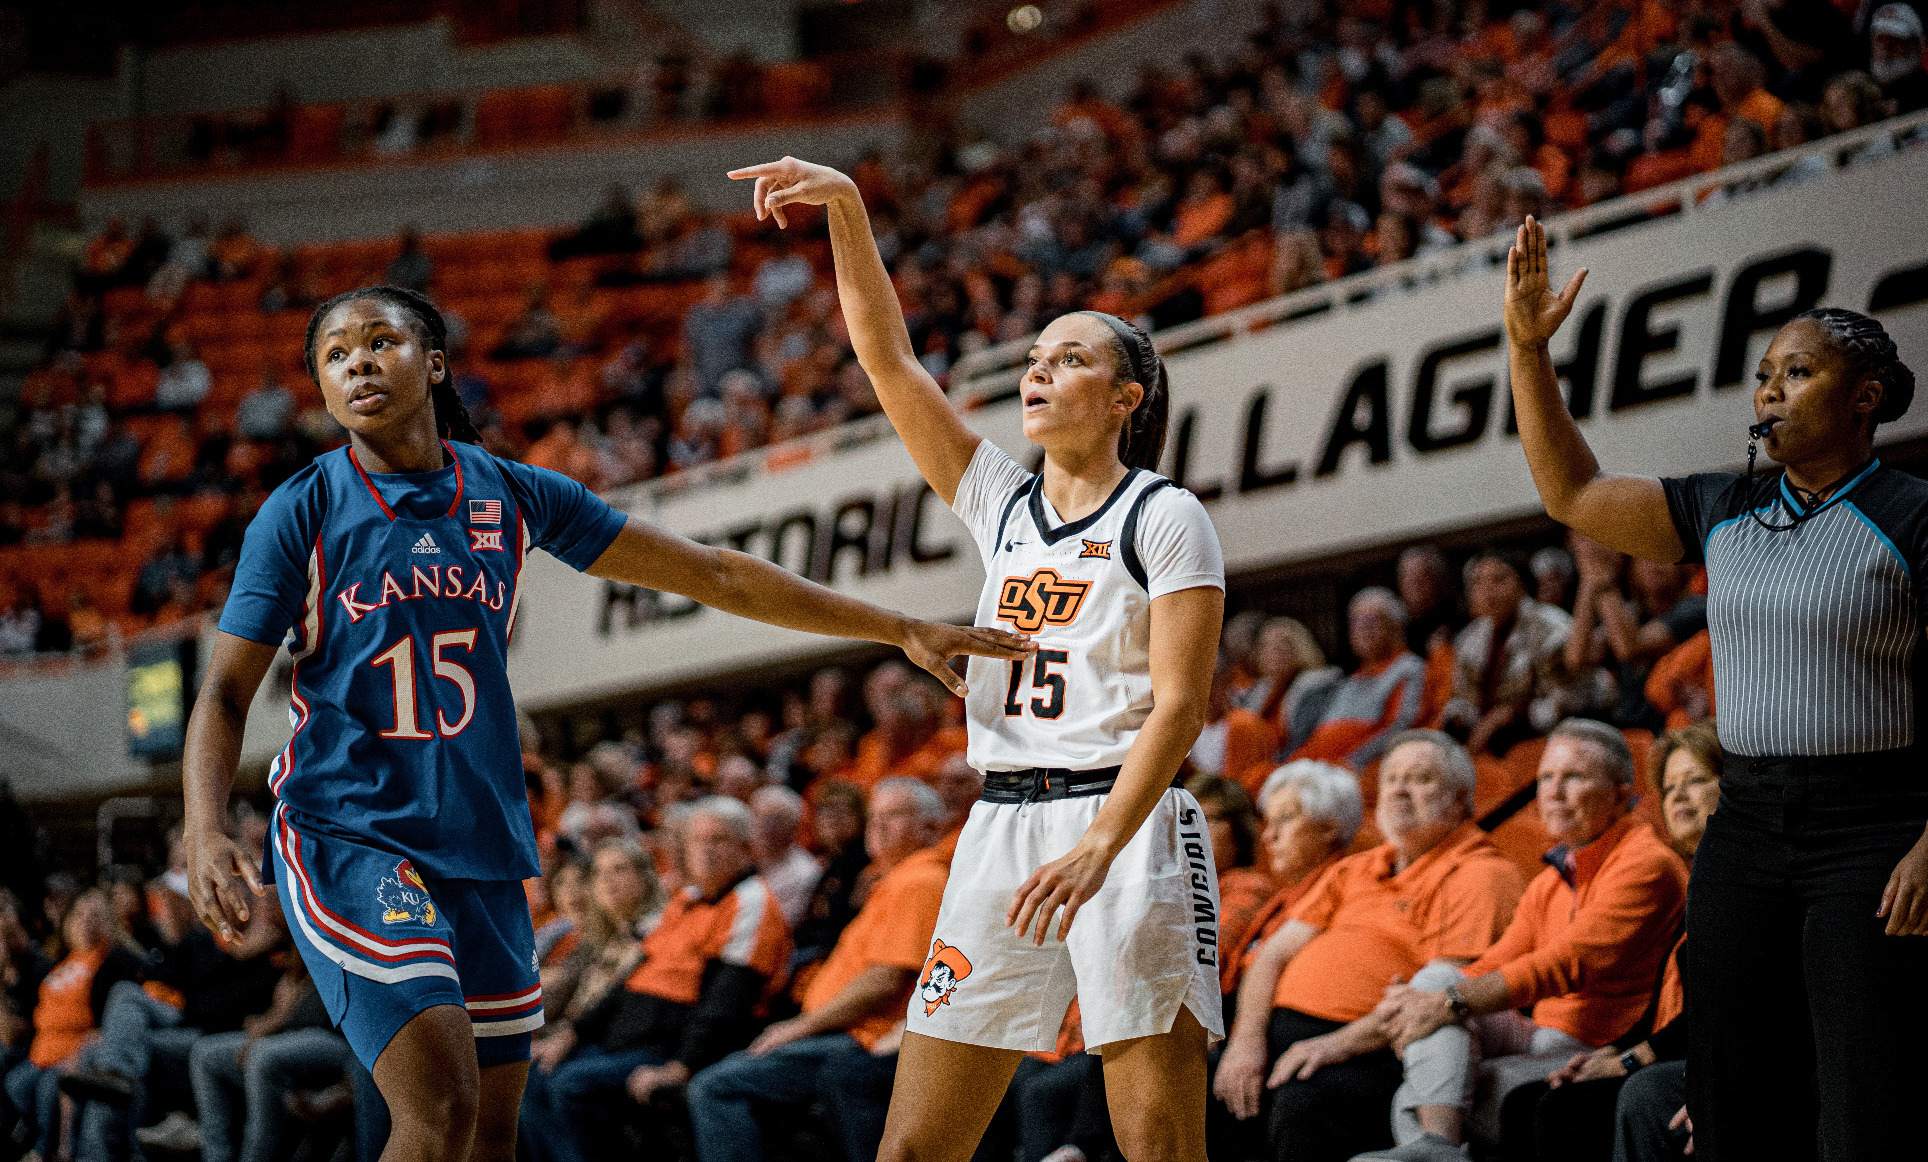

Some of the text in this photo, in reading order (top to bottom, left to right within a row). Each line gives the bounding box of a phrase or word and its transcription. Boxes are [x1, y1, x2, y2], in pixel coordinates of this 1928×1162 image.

[411, 546, 441, 554] adidas
[338, 564, 506, 623] KANSAS
[995, 567, 1094, 634] OSU
[370, 627, 479, 740] 15
[401, 891, 420, 905] KU
